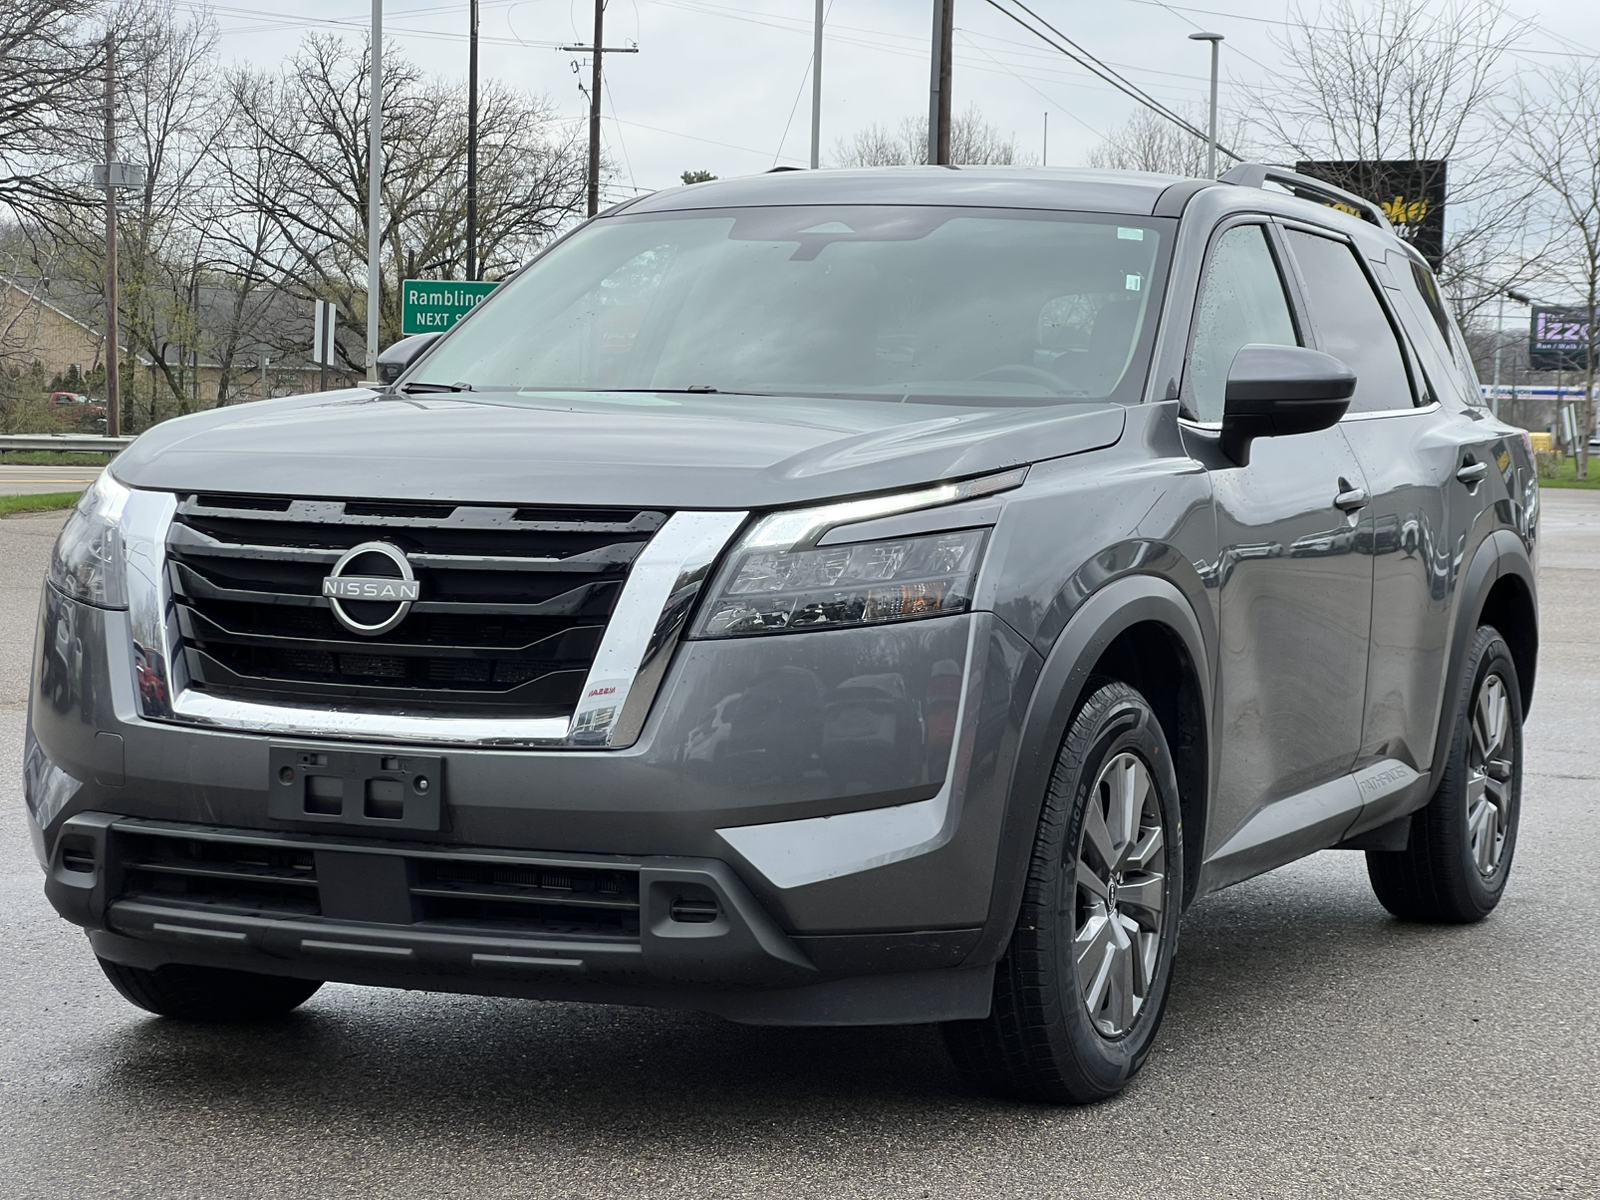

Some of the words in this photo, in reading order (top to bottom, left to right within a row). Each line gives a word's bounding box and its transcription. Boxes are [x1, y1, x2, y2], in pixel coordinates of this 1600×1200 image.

[416, 312, 449, 326] NEXT
[1490, 388, 1531, 396] MARAHON
[324, 581, 416, 598] NISSAN
[1069, 783, 1087, 847] CROSS
